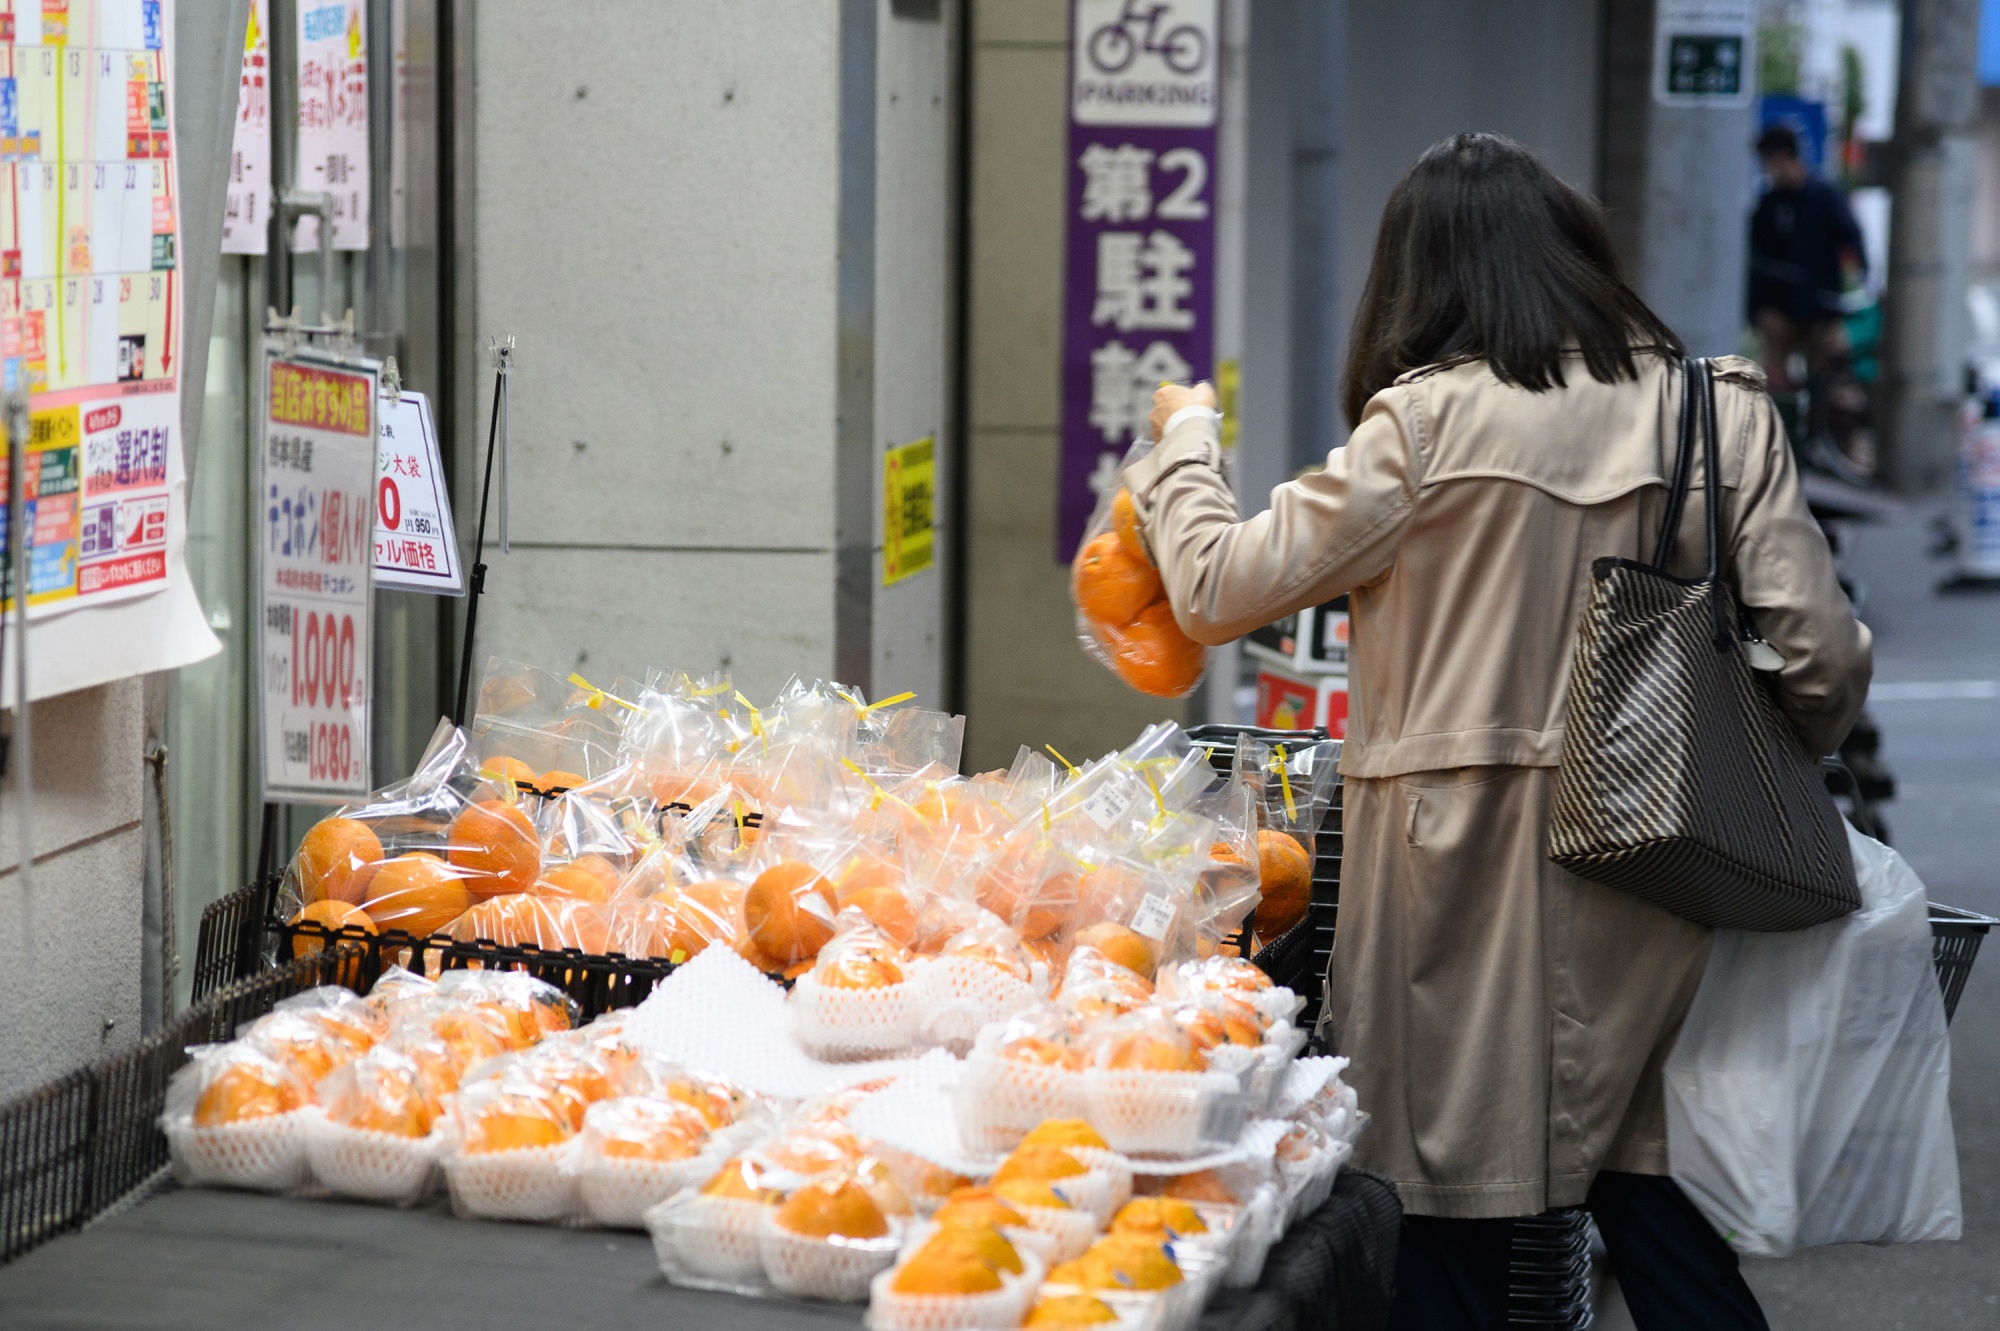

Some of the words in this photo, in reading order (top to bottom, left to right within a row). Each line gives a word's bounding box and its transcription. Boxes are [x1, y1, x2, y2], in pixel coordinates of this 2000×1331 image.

[69, 52, 80, 77] 13
[100, 54, 110, 77] 14
[95, 165, 105, 189] 21
[125, 165, 136, 189] 22
[120, 278, 131, 302] 29
[150, 277, 161, 301] 30
[273, 367, 366, 433] 当店おすすめ品
[115, 426, 168, 485] 選択制
